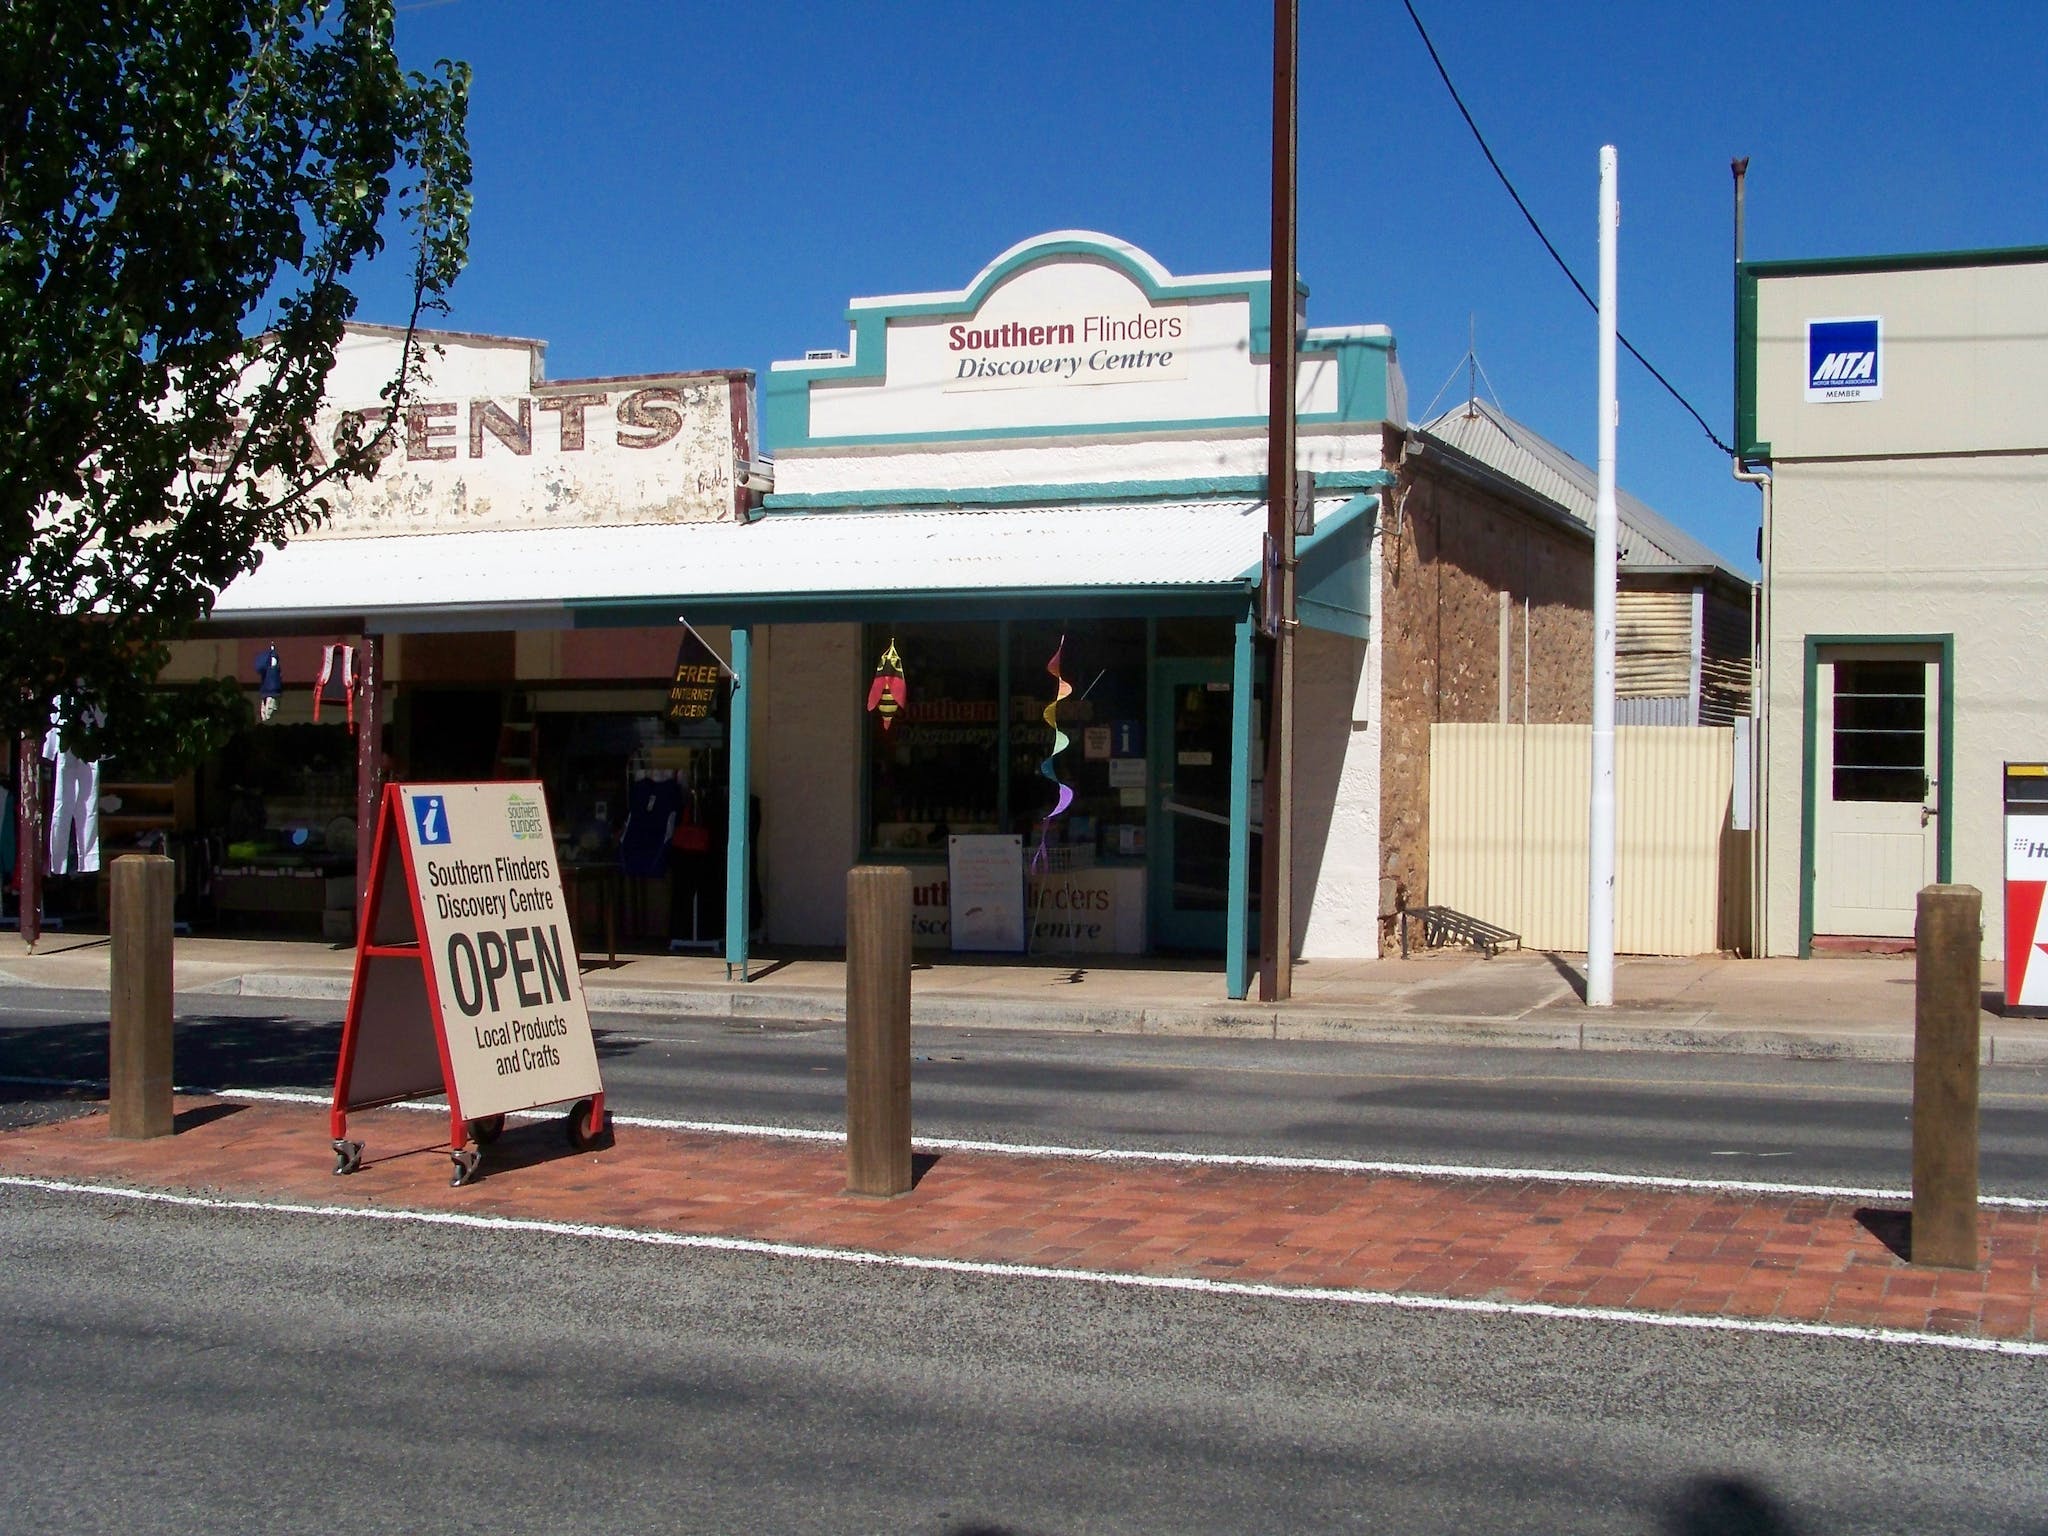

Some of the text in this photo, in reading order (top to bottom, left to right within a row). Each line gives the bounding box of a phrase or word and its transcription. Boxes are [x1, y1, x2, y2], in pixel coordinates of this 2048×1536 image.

[949, 313, 1182, 350] Southern Flinders
[957, 349, 1174, 379] Discovery Centre
[1812, 351, 1875, 380] MTA
[1826, 390, 1861, 398] MEMBER
[676, 664, 718, 683] FREE
[671, 687, 714, 701] INTERNET
[670, 704, 707, 717] ACCESS
[428, 856, 550, 887] Southern Flinders
[436, 887, 554, 920] Discovery Centre
[1028, 883, 1110, 911] linders
[447, 924, 571, 1017] OPEN
[475, 1014, 567, 1049] Local Products
[496, 1044, 560, 1076] and Crafts
